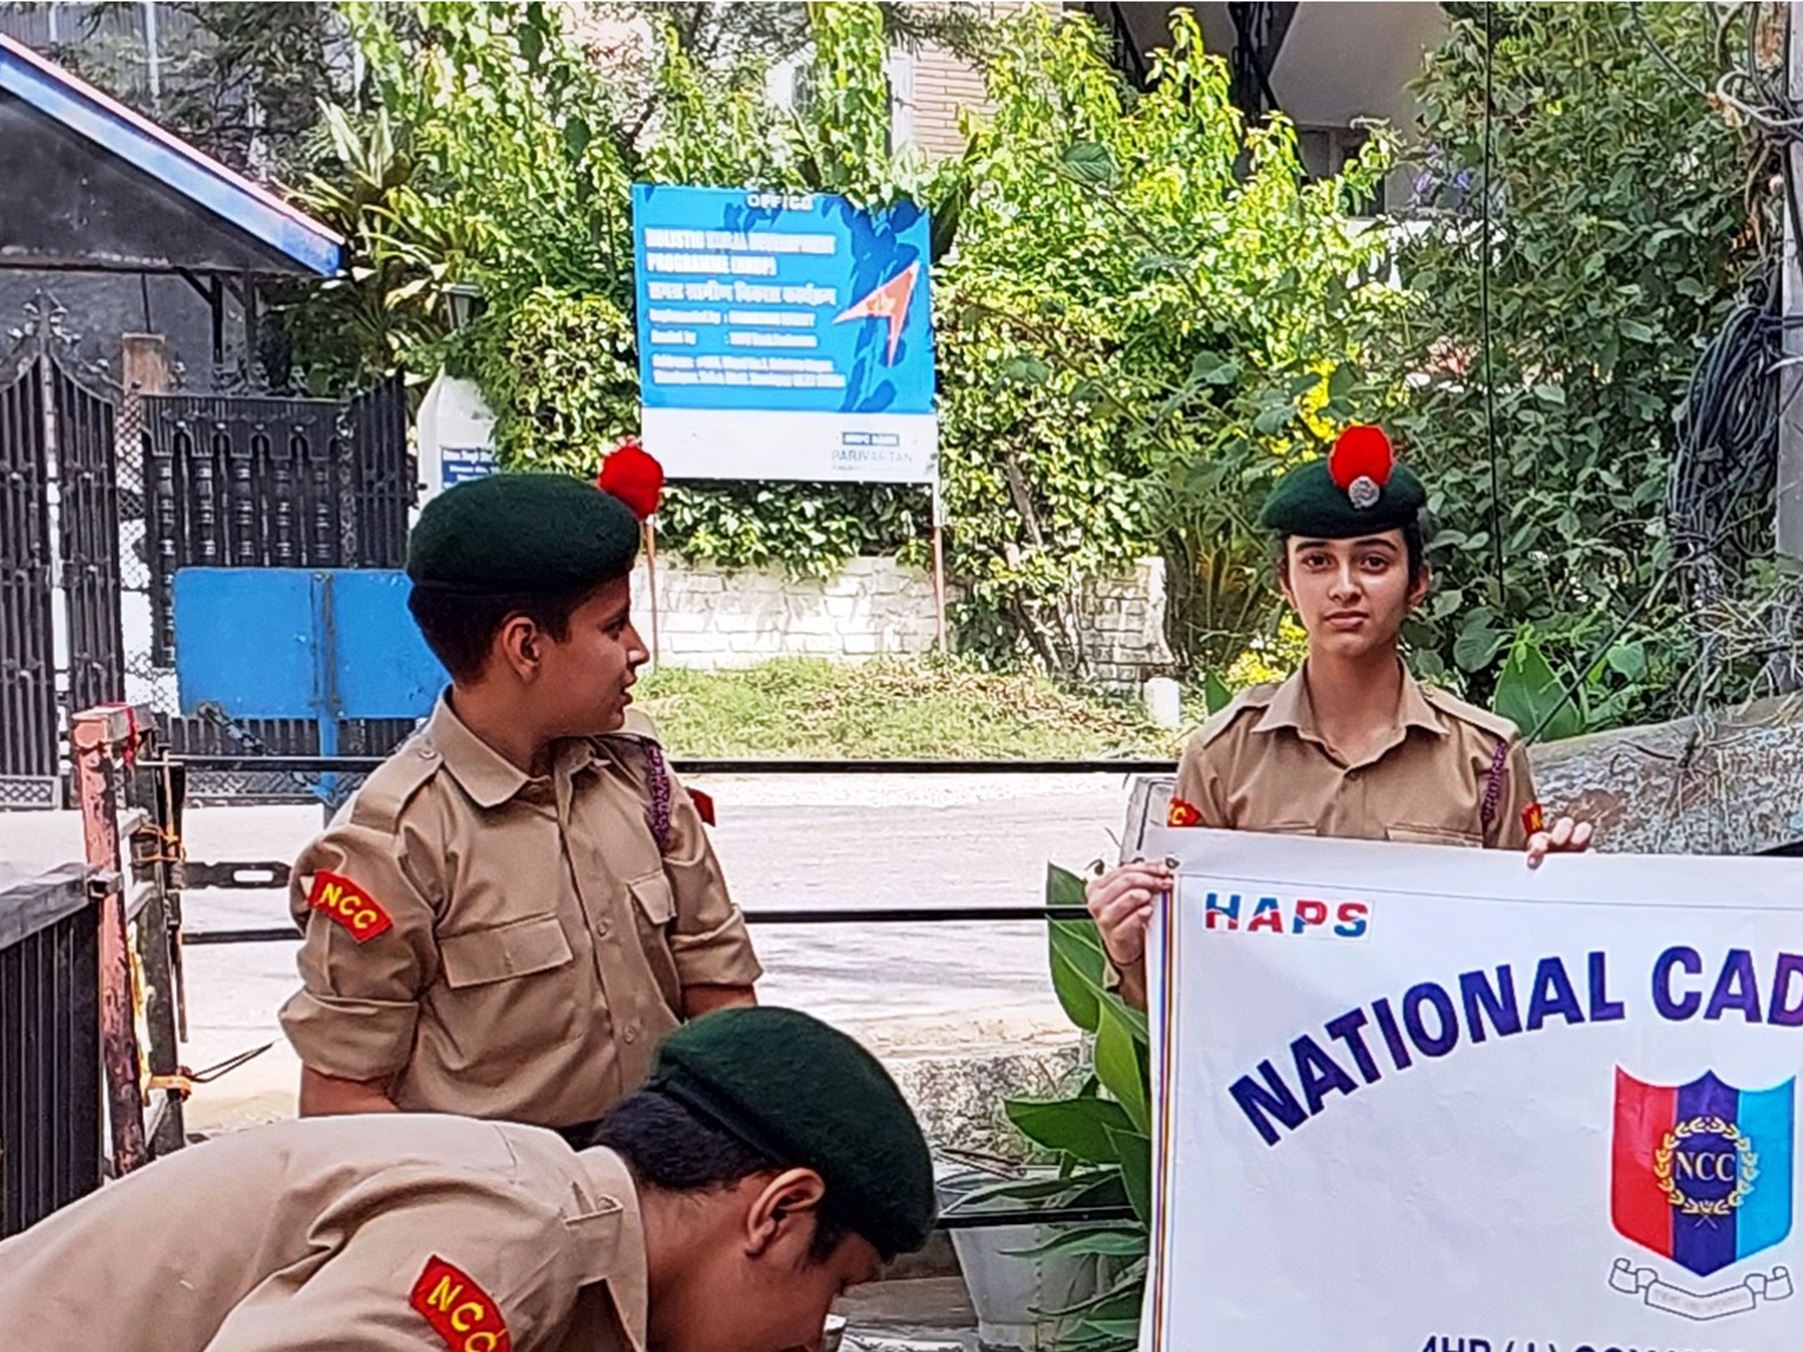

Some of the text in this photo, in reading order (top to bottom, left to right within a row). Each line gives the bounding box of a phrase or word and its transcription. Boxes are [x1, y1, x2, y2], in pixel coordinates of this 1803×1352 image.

[318, 882, 378, 930] NCC
[1204, 893, 1369, 938] HAPS
[1228, 950, 1626, 1148] NATIONAL
[1675, 1151, 1736, 1182] NCC
